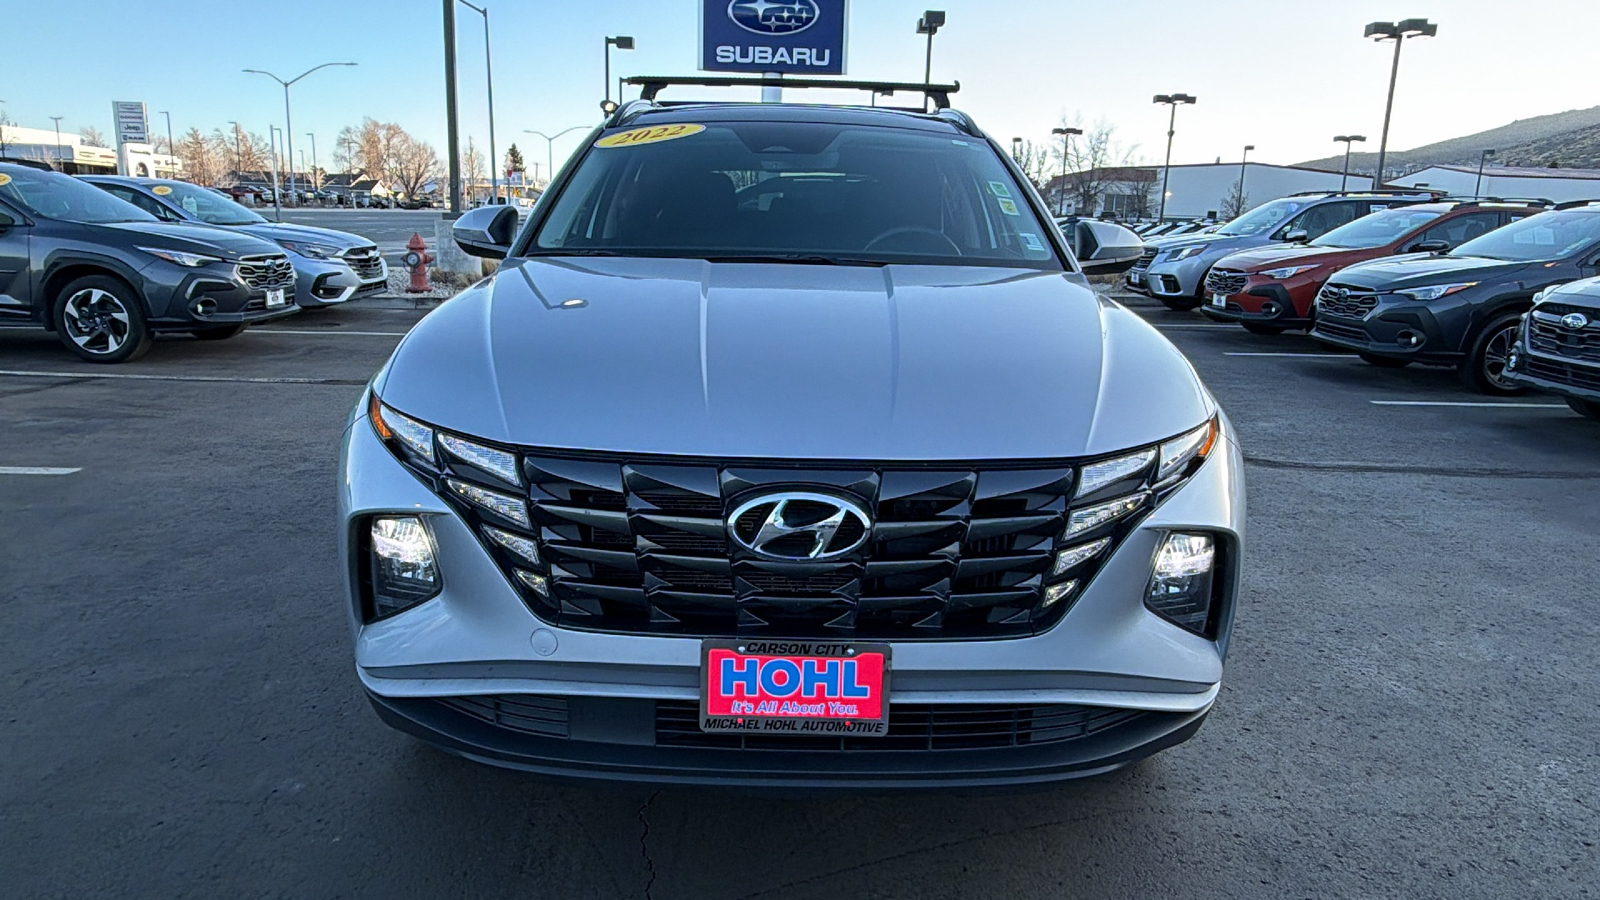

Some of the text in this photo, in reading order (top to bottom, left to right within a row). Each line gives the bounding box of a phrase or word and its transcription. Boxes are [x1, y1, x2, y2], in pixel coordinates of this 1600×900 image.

[716, 45, 830, 66] SUBARU
[613, 125, 687, 145] 2022
[746, 642, 851, 656] CARSON CITY
[720, 658, 870, 698] HOHL
[731, 700, 859, 715] It's All About You.
[704, 718, 884, 733] MICHAEL HOHL AUTOMOTIVE
